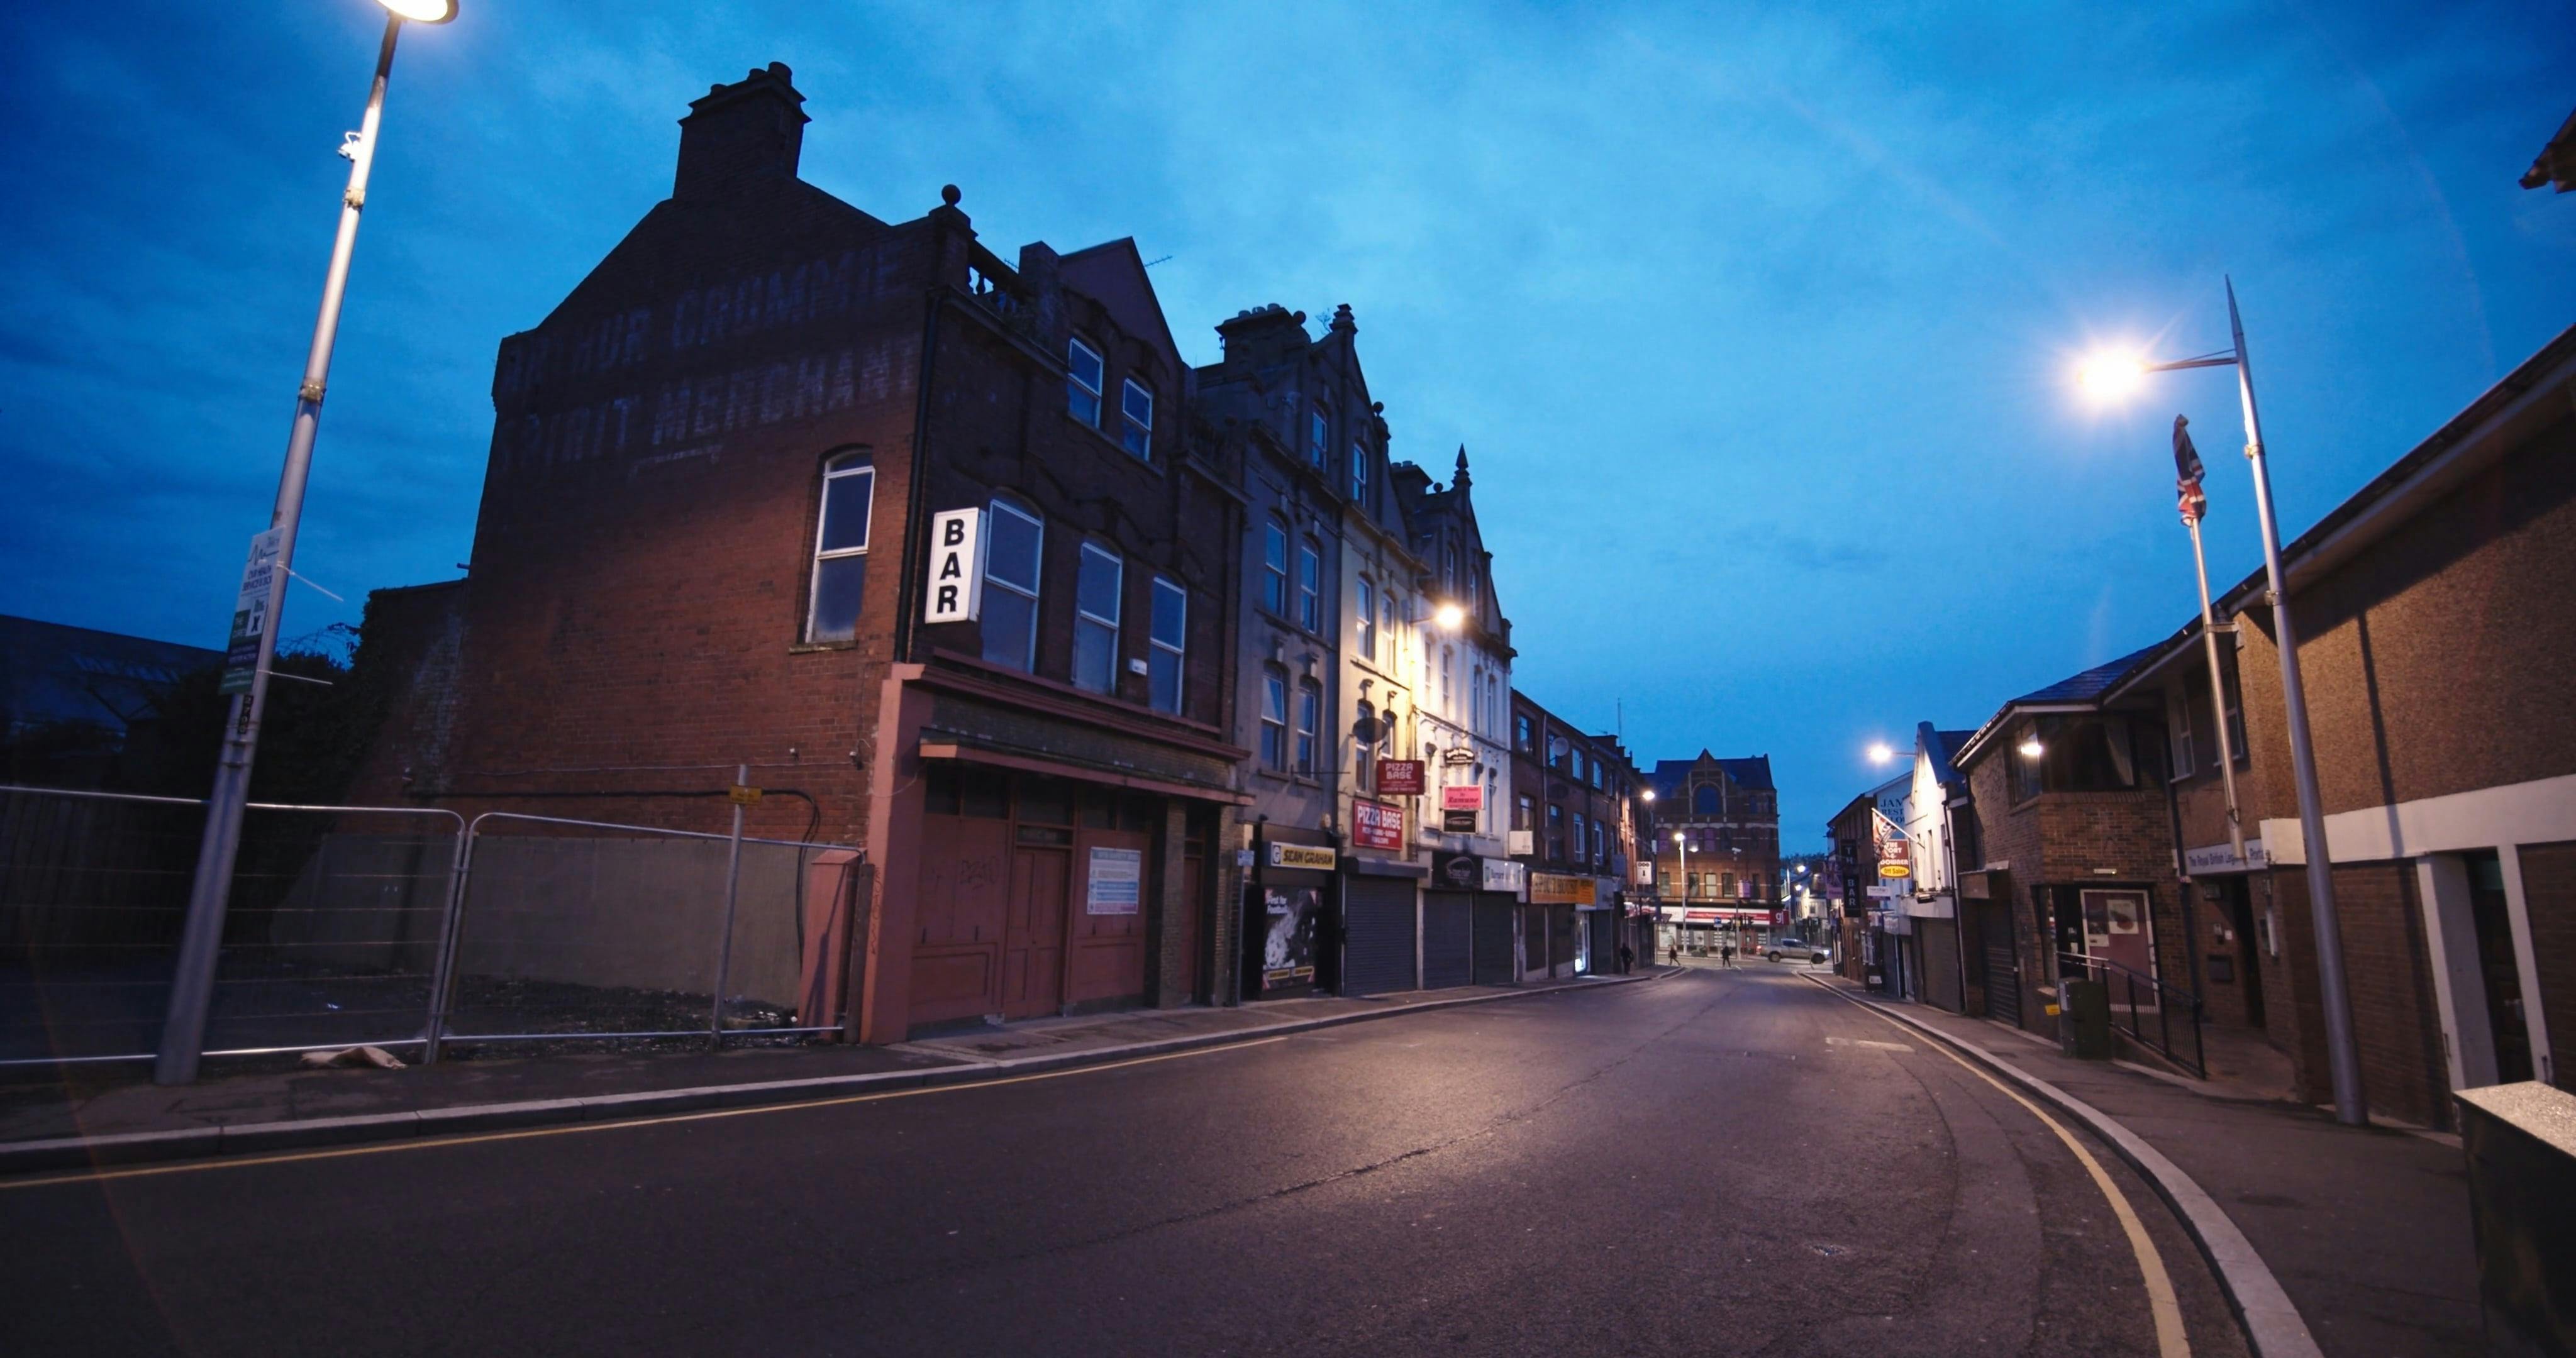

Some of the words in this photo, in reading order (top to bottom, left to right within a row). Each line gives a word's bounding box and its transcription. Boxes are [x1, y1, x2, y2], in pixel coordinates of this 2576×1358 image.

[937, 519, 964, 614] BAR
[1385, 763, 1413, 771] PIZZA
[1357, 805, 1380, 827] PIZZA
[1382, 810, 1401, 830] BASE
[1284, 849, 1303, 863] SEAN
[1304, 851, 1333, 865] GRAHAM
[2197, 855, 2209, 867] Royal
[2209, 852, 2224, 865] British
[1847, 879, 1856, 906] BAR
